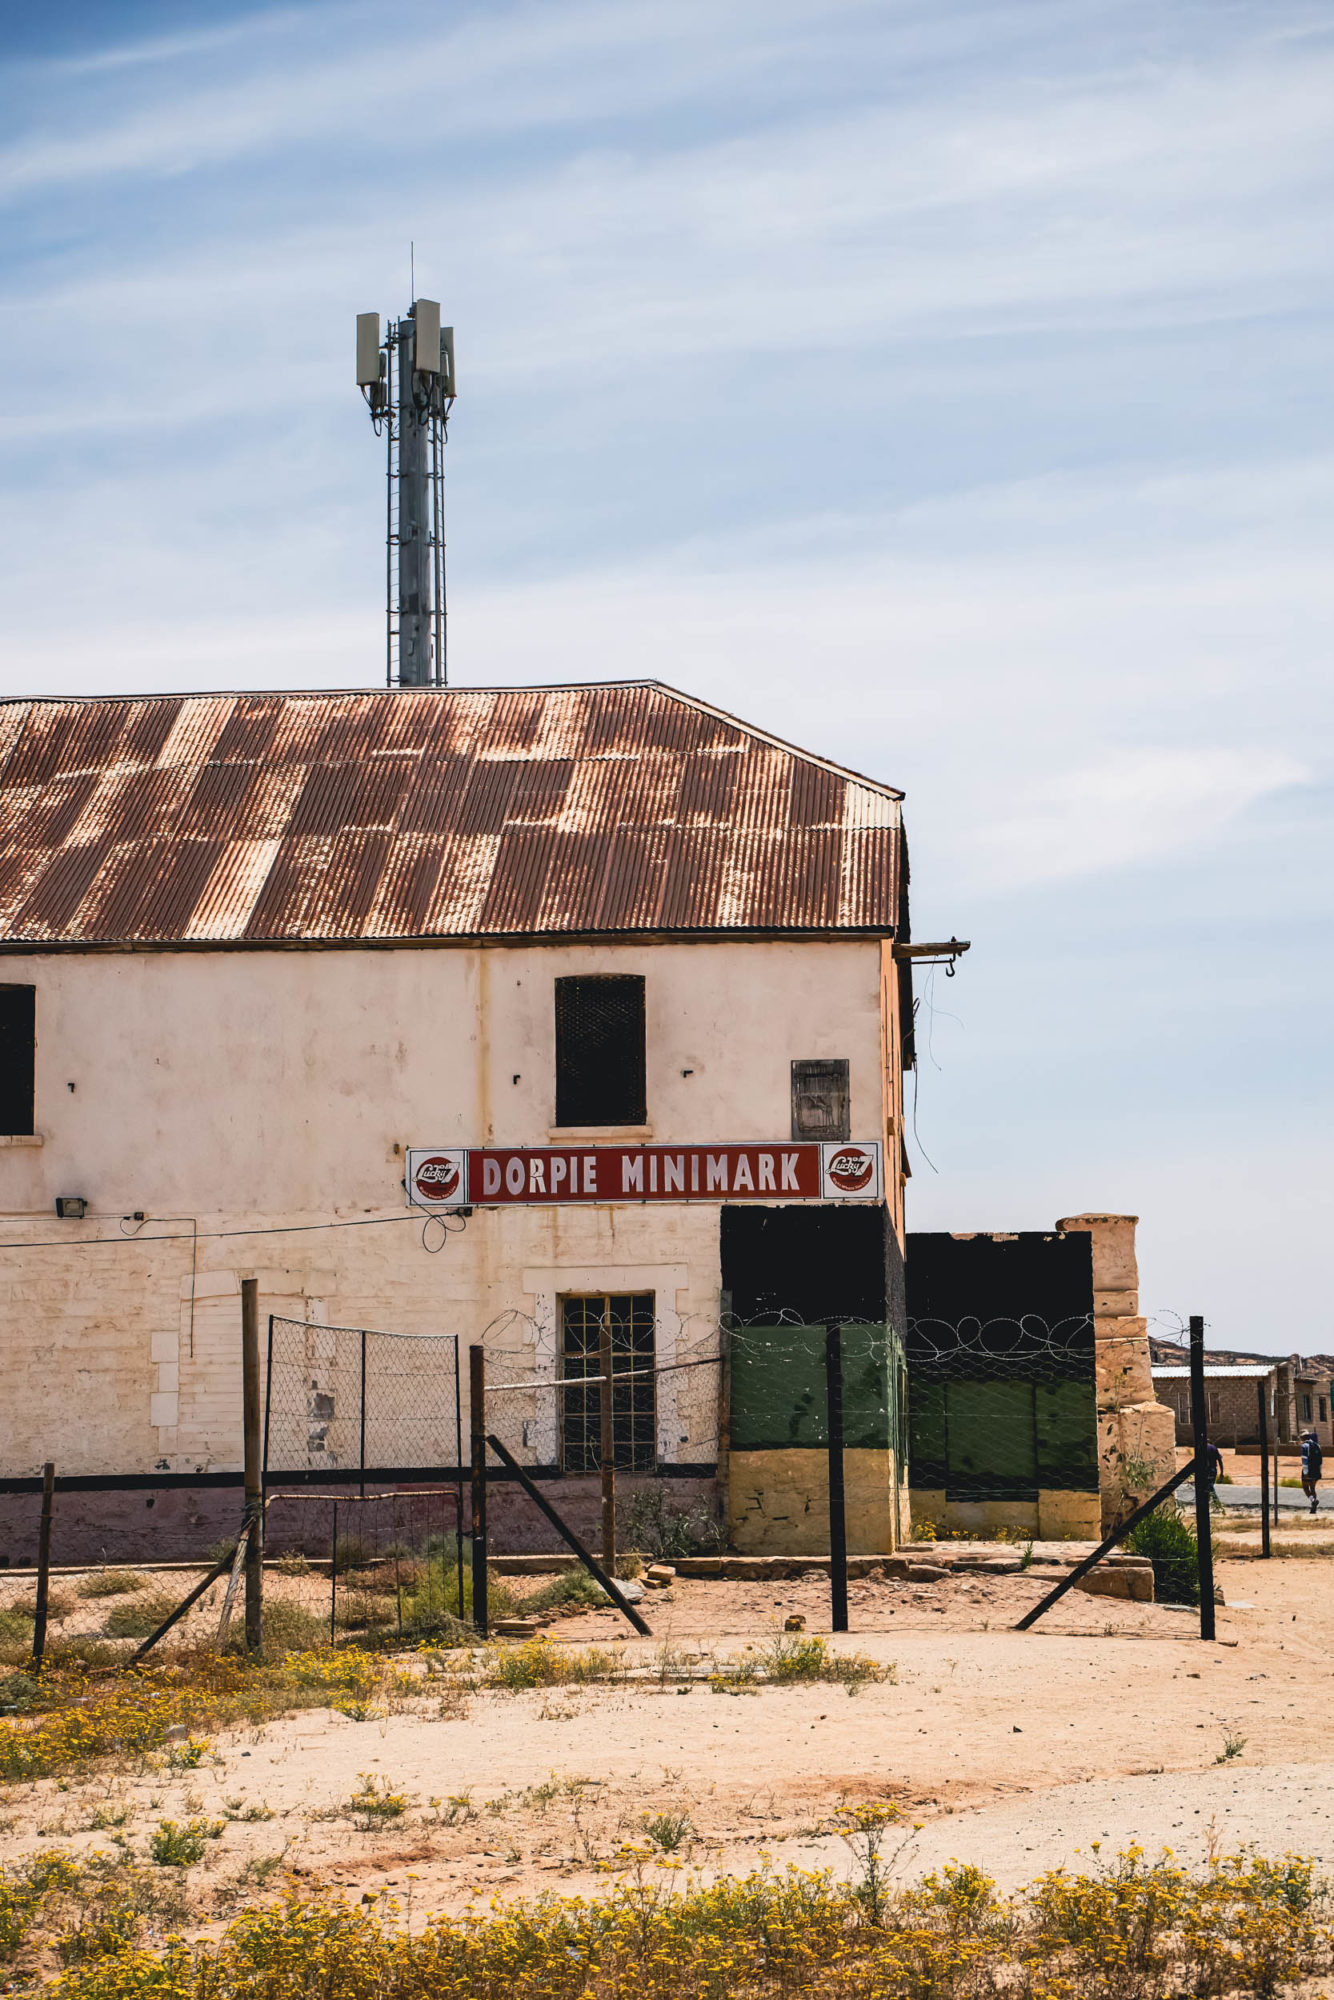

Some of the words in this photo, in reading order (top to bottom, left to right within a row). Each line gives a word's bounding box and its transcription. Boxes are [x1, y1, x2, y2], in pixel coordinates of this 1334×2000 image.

[412, 1164, 447, 1183] Lucky
[441, 1162, 460, 1184] 7
[483, 1156, 597, 1195] DORPIE
[622, 1153, 800, 1192] MINIMARK
[825, 1155, 860, 1176] Lucky
[854, 1154, 873, 1177] 7
